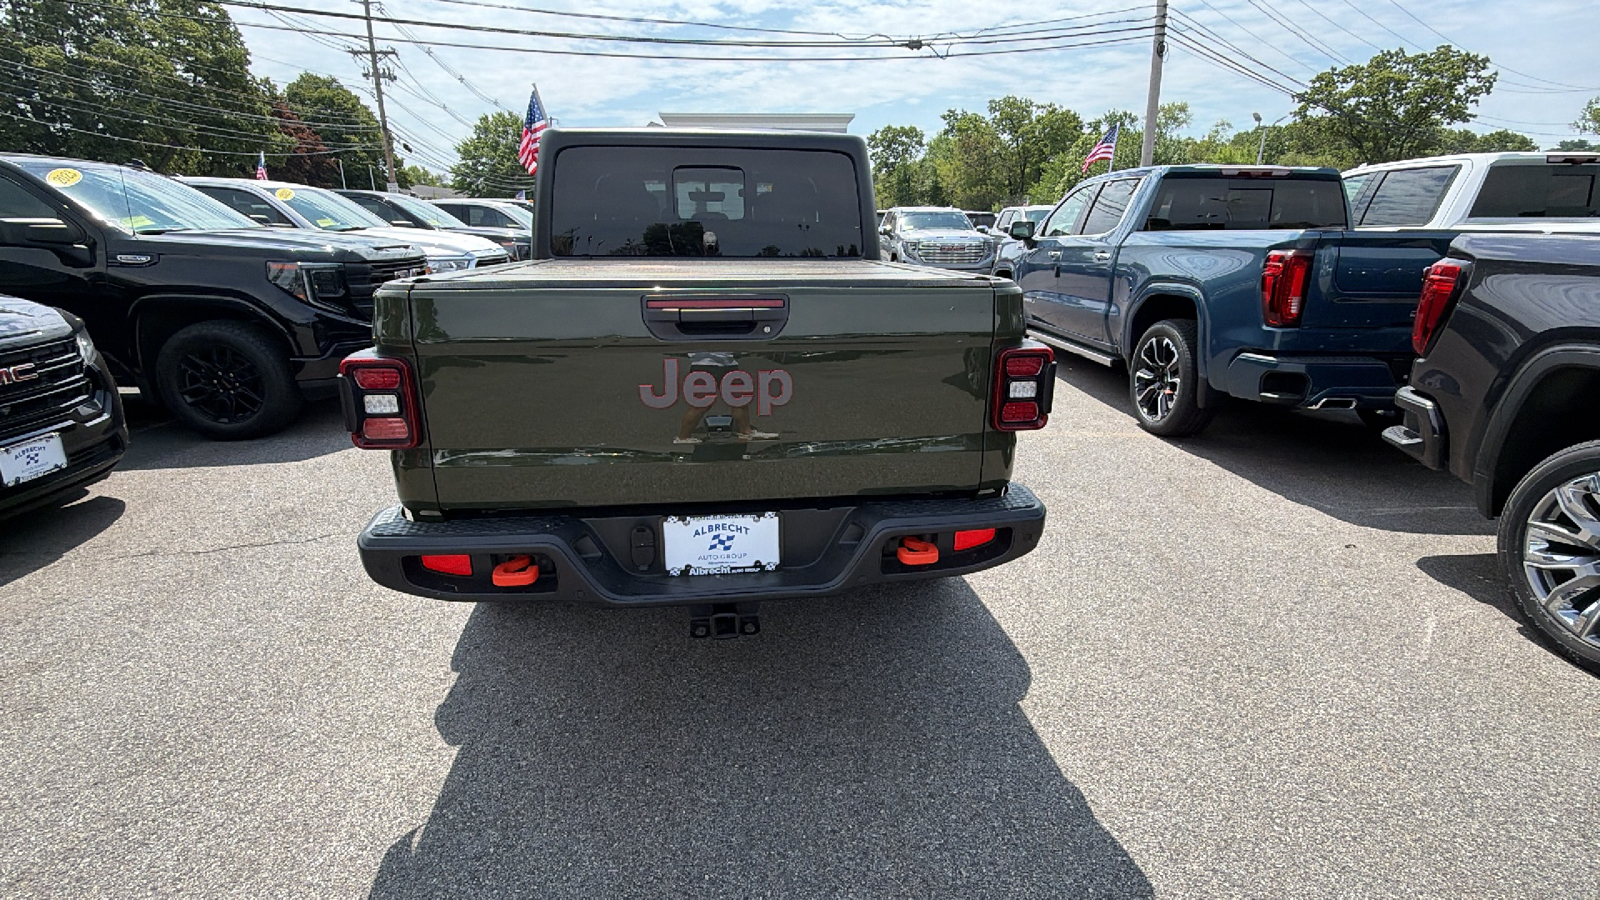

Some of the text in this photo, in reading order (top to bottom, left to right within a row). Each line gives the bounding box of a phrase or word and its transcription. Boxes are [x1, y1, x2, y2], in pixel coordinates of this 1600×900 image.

[638, 358, 793, 416] Jeep
[14, 446, 46, 460] ALBRECHT
[693, 523, 750, 538] ALBRECHT
[720, 552, 748, 560] GROUP
[688, 565, 731, 576] Albrecht
